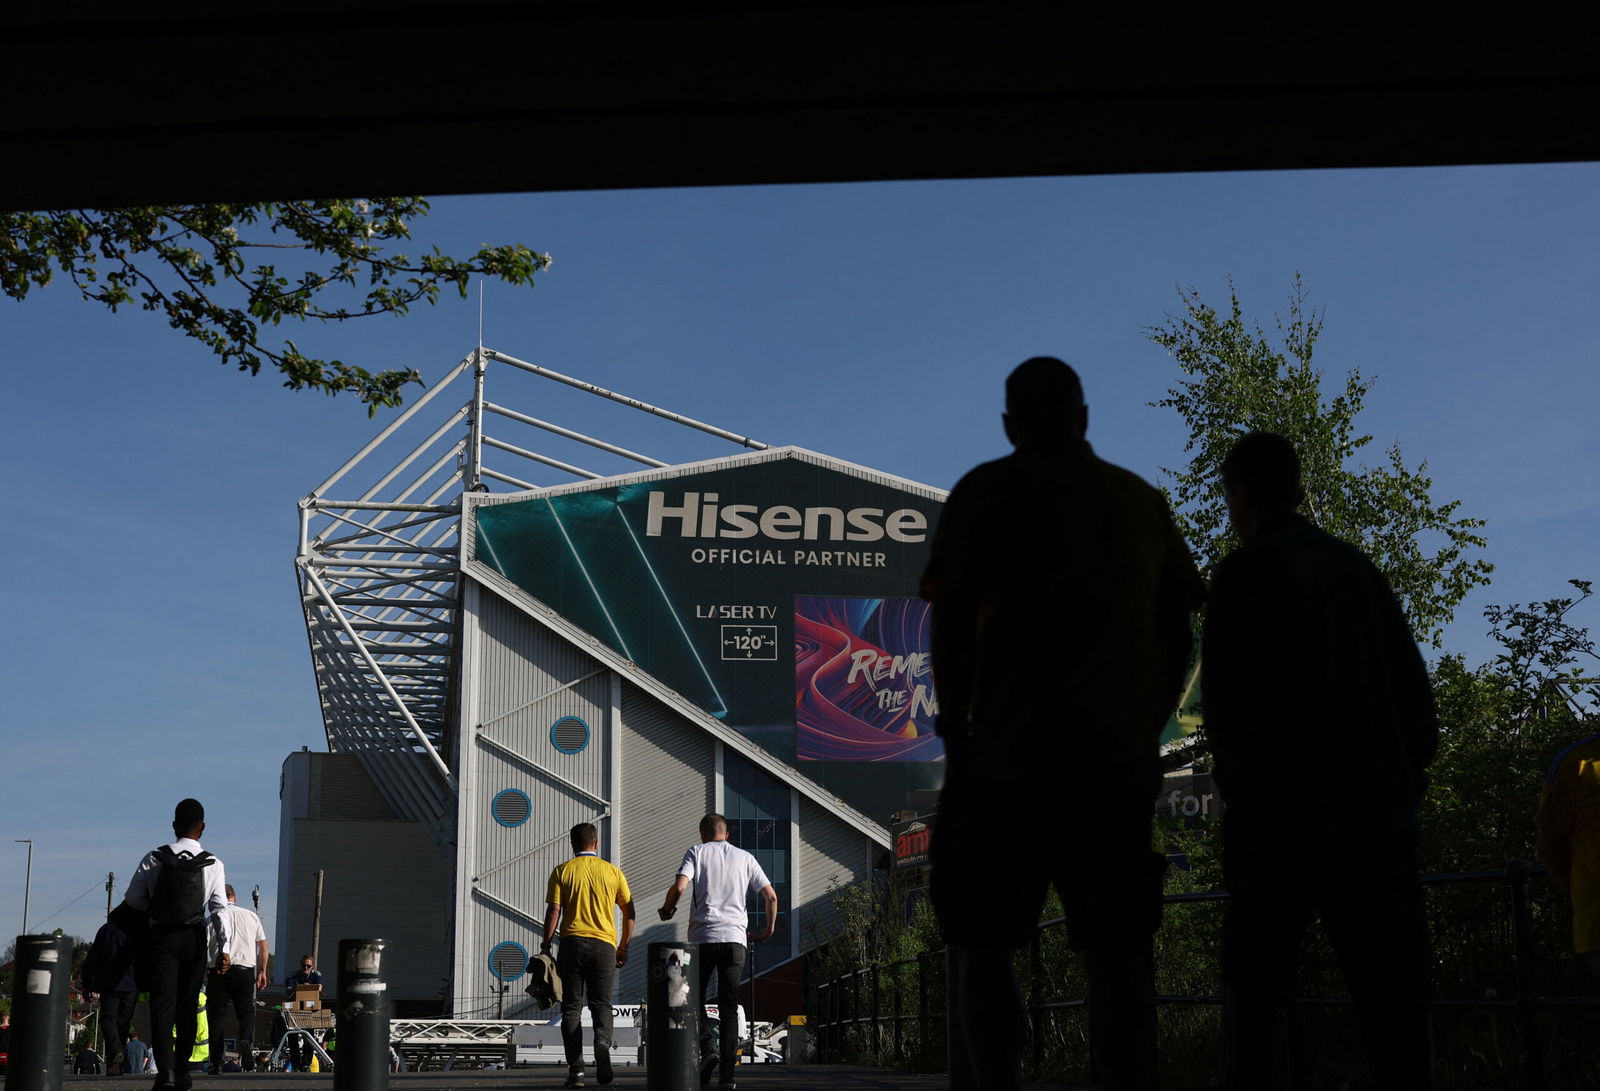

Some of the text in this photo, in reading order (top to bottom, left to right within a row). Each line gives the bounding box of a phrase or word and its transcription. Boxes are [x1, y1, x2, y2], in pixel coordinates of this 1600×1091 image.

[645, 490, 928, 543] Hisense
[691, 548, 886, 568] OFFICIAL PARTNER
[696, 604, 777, 619] LASER TV
[847, 648, 936, 692] REME
[875, 688, 908, 712] THE
[1167, 789, 1213, 817] for
[612, 1007, 638, 1017] OWE
